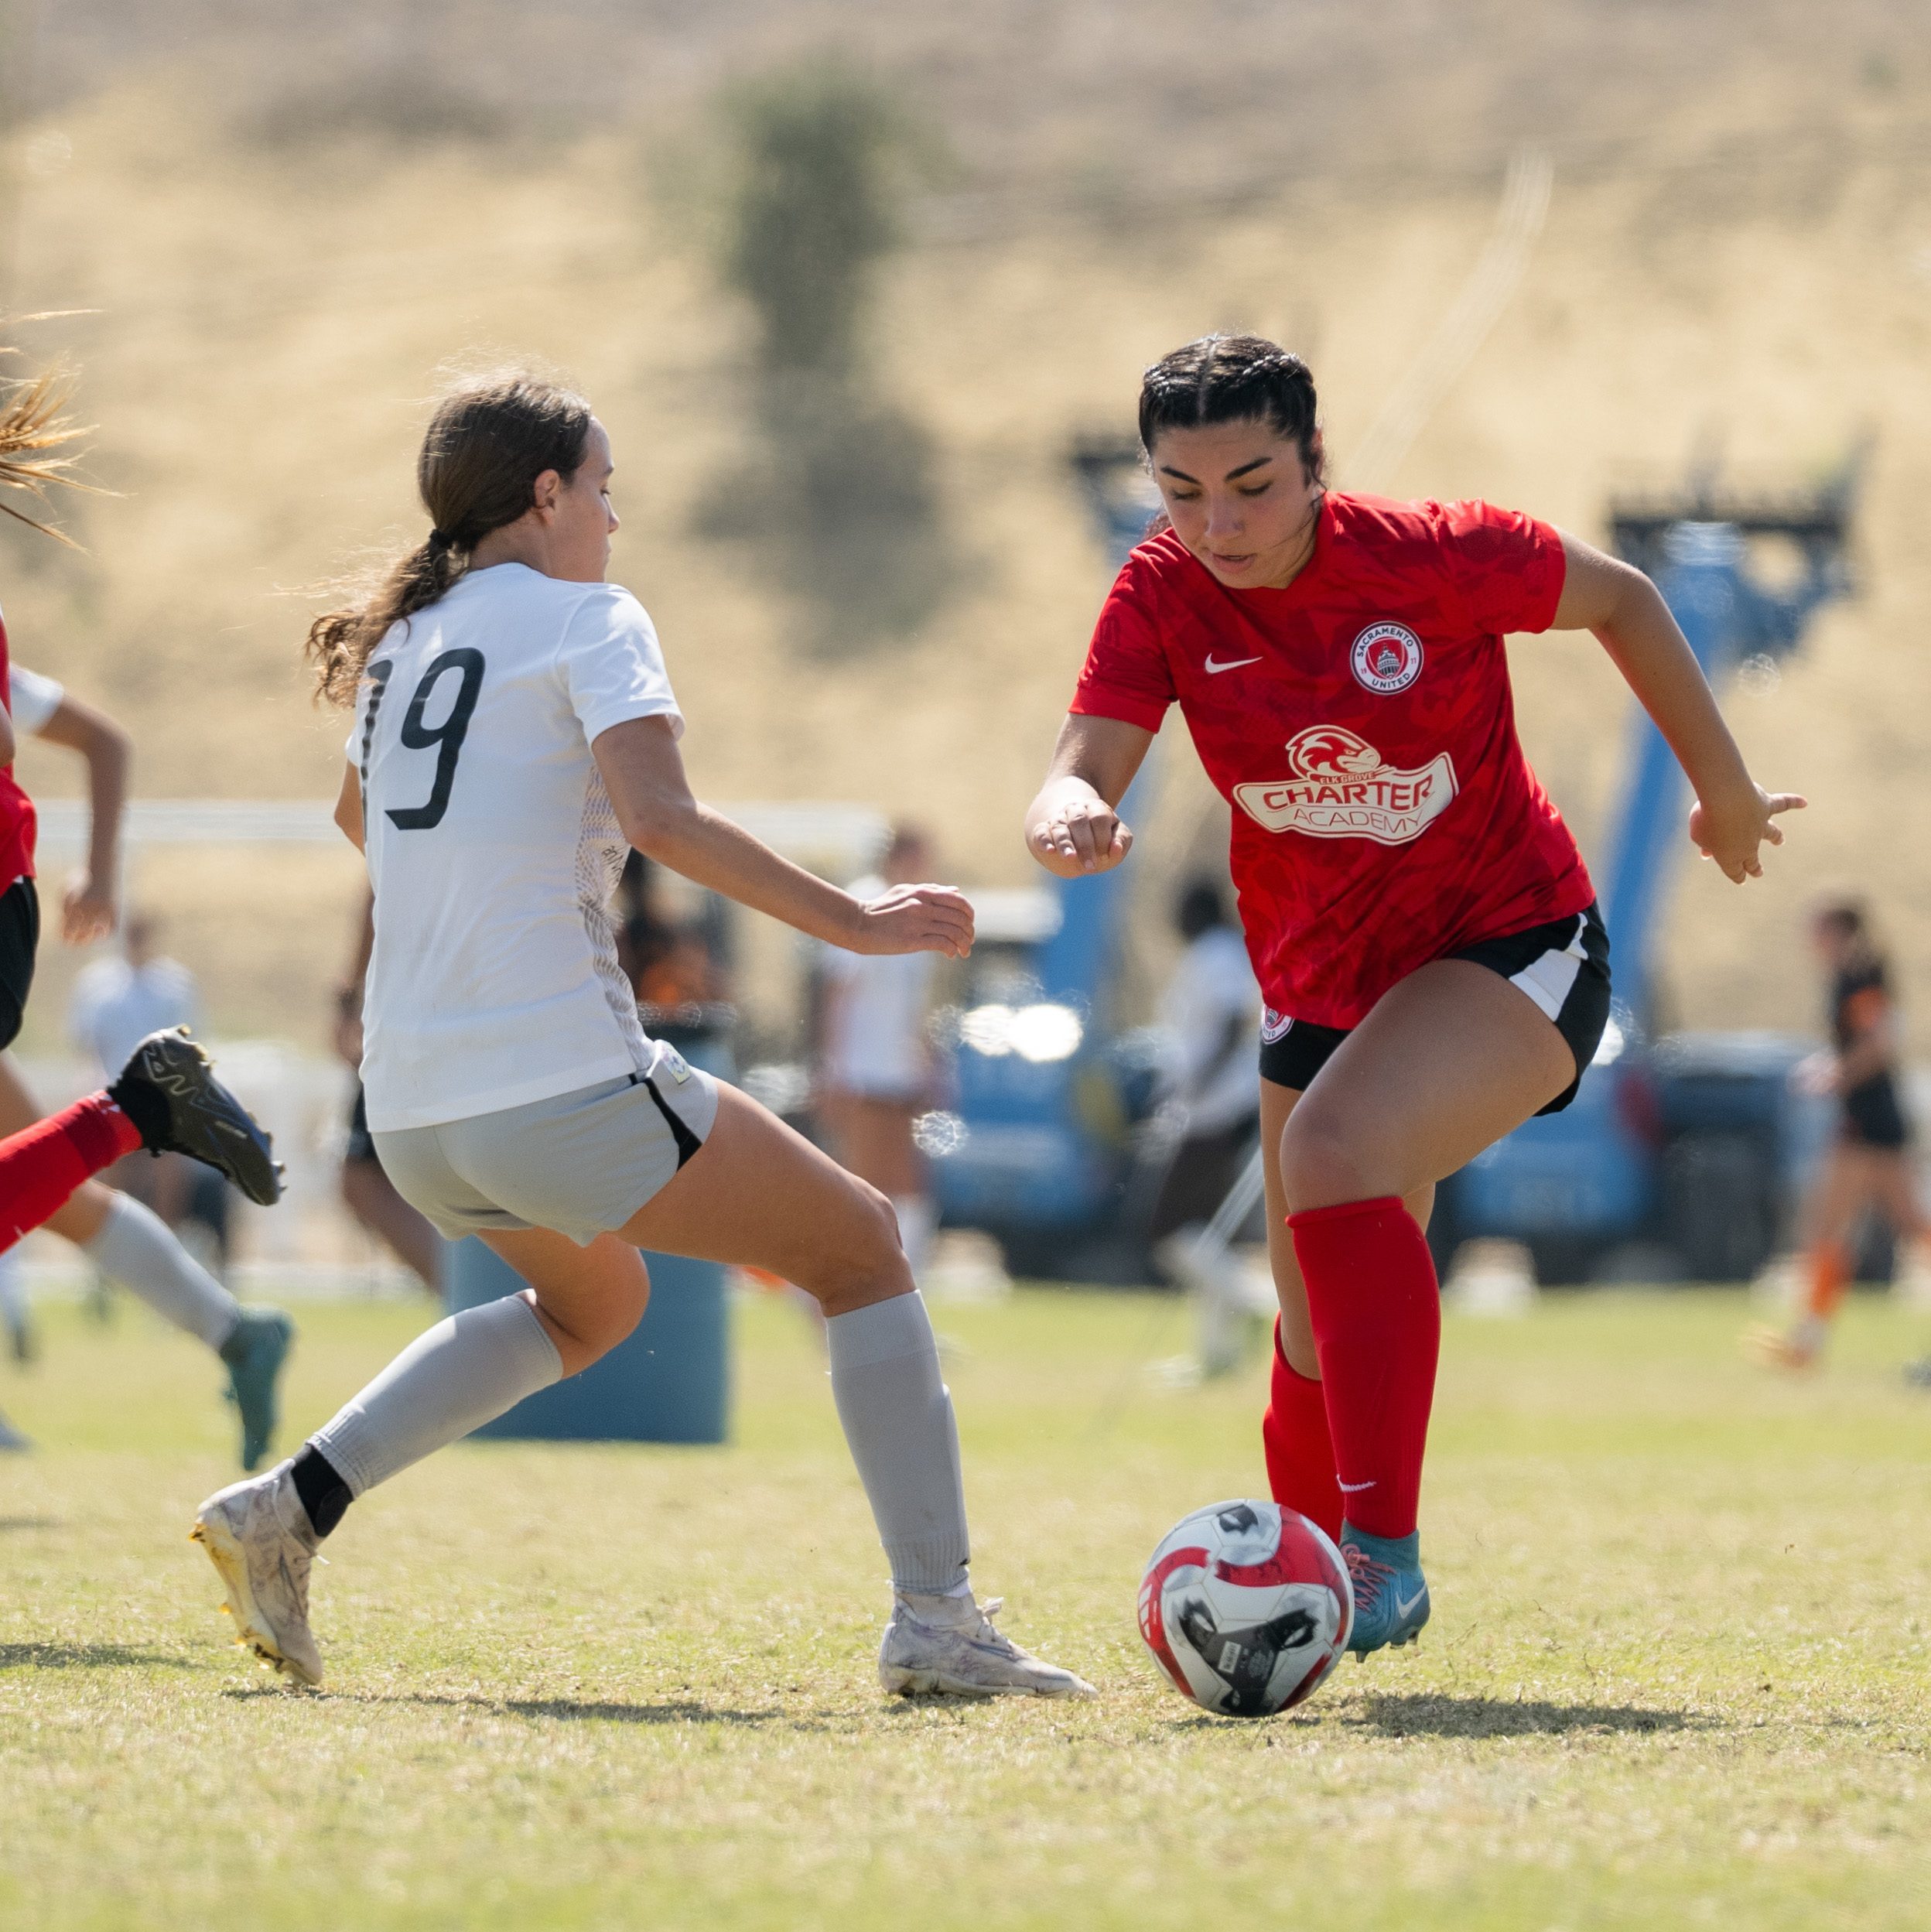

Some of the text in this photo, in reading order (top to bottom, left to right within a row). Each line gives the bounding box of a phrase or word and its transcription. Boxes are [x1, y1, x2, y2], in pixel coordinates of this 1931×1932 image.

[1357, 627, 1413, 657] SACRAMENTO
[1372, 672, 1410, 689] UNITED
[361, 647, 485, 842] 19
[1341, 771, 1374, 783] GROVE
[1263, 774, 1434, 810] CHARTER
[1294, 809, 1425, 833] ACADEMY
